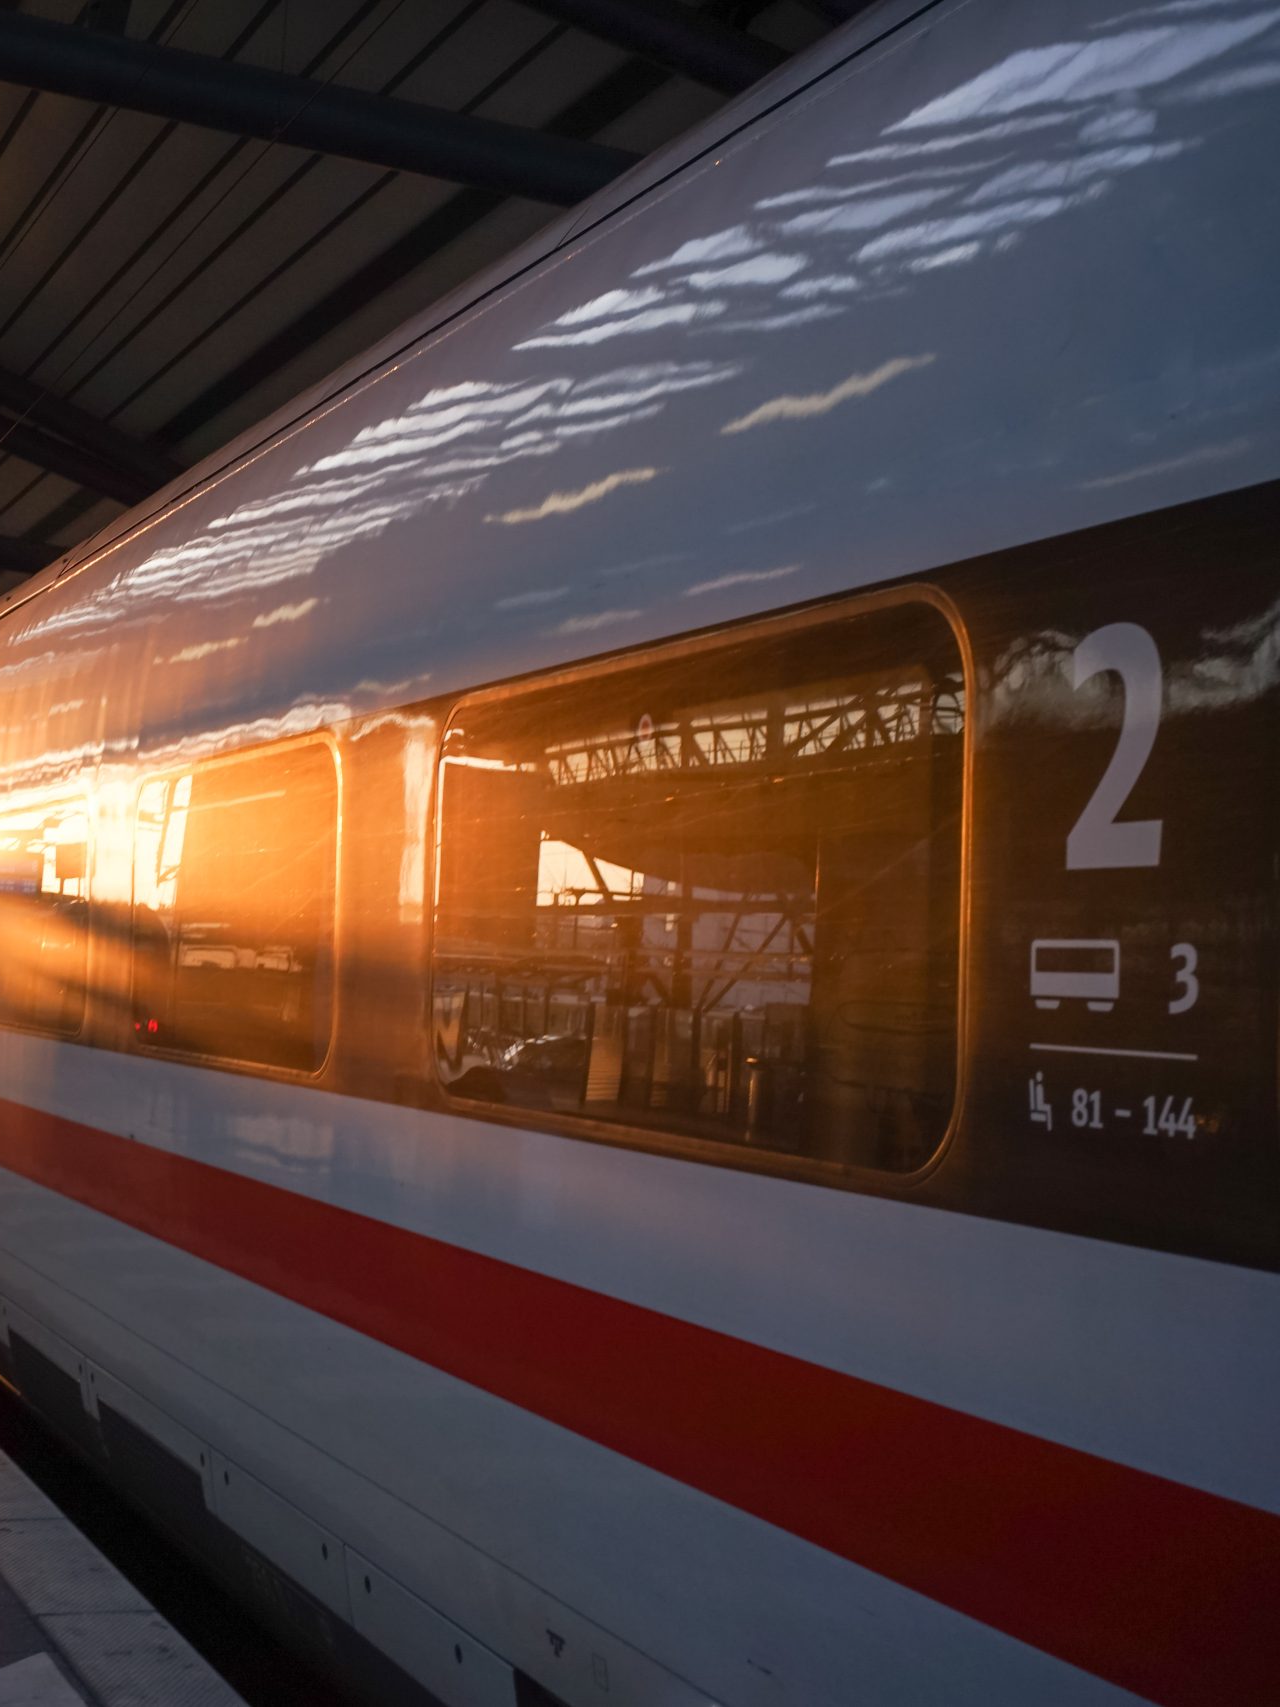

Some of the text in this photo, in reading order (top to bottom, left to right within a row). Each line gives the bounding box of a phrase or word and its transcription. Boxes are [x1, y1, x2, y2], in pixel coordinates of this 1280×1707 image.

[1065, 621, 1164, 871] 2
[1167, 941, 1200, 1016] 3
[1071, 1087, 1104, 1129] 81
[1142, 1094, 1198, 1140] 144
